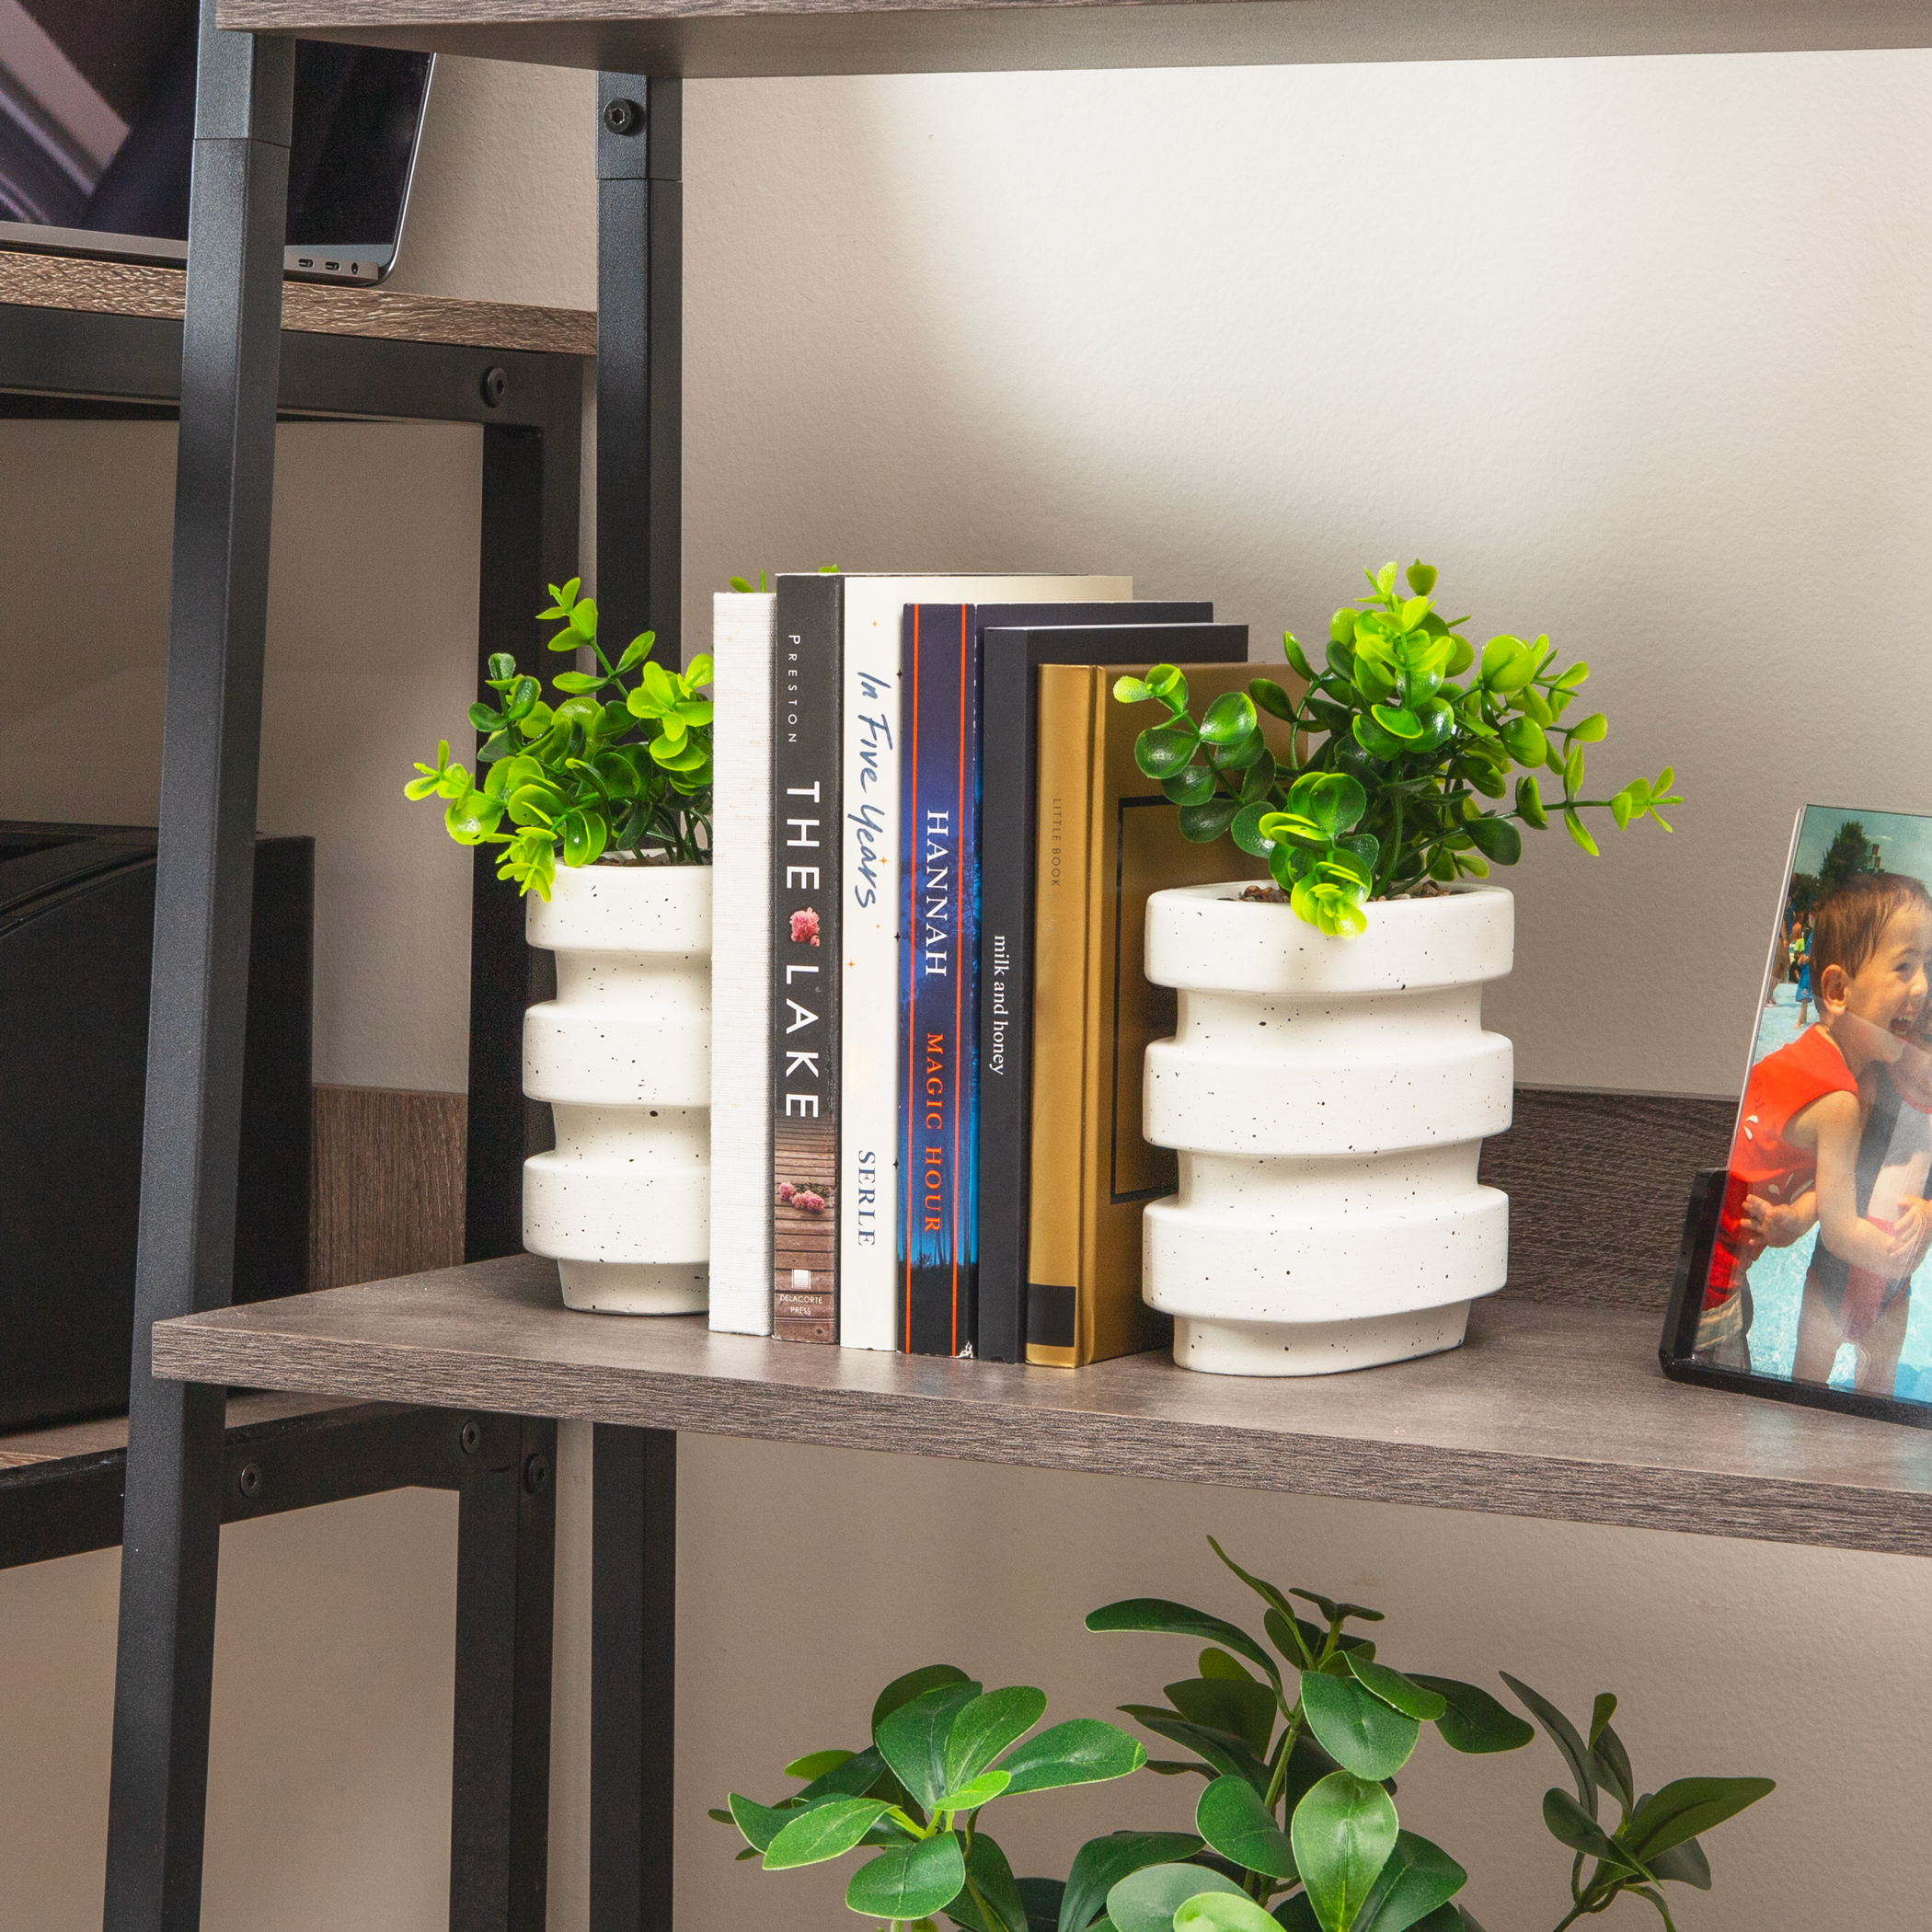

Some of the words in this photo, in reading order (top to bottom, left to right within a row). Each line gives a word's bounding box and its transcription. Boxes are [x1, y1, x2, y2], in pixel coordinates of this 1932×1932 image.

[788, 634, 801, 743] PRESTON
[857, 671, 892, 700] In
[857, 712, 894, 795] Five
[786, 780, 821, 891] THE
[846, 803, 886, 909] Years
[1052, 799, 1063, 841] LITTLE
[925, 810, 949, 977] HANNAH
[1051, 847, 1062, 887] BOOK
[994, 935, 1010, 977] milk
[993, 981, 1009, 1015] and
[785, 964, 820, 1119] LAKE
[925, 1032, 945, 1131] MAGIC
[988, 1019, 1009, 1076] honey
[857, 1149, 877, 1247] SERLE
[924, 1145, 943, 1233] HOUR
[779, 1294, 823, 1305] DELACORTE
[789, 1306, 811, 1316] PRESS
